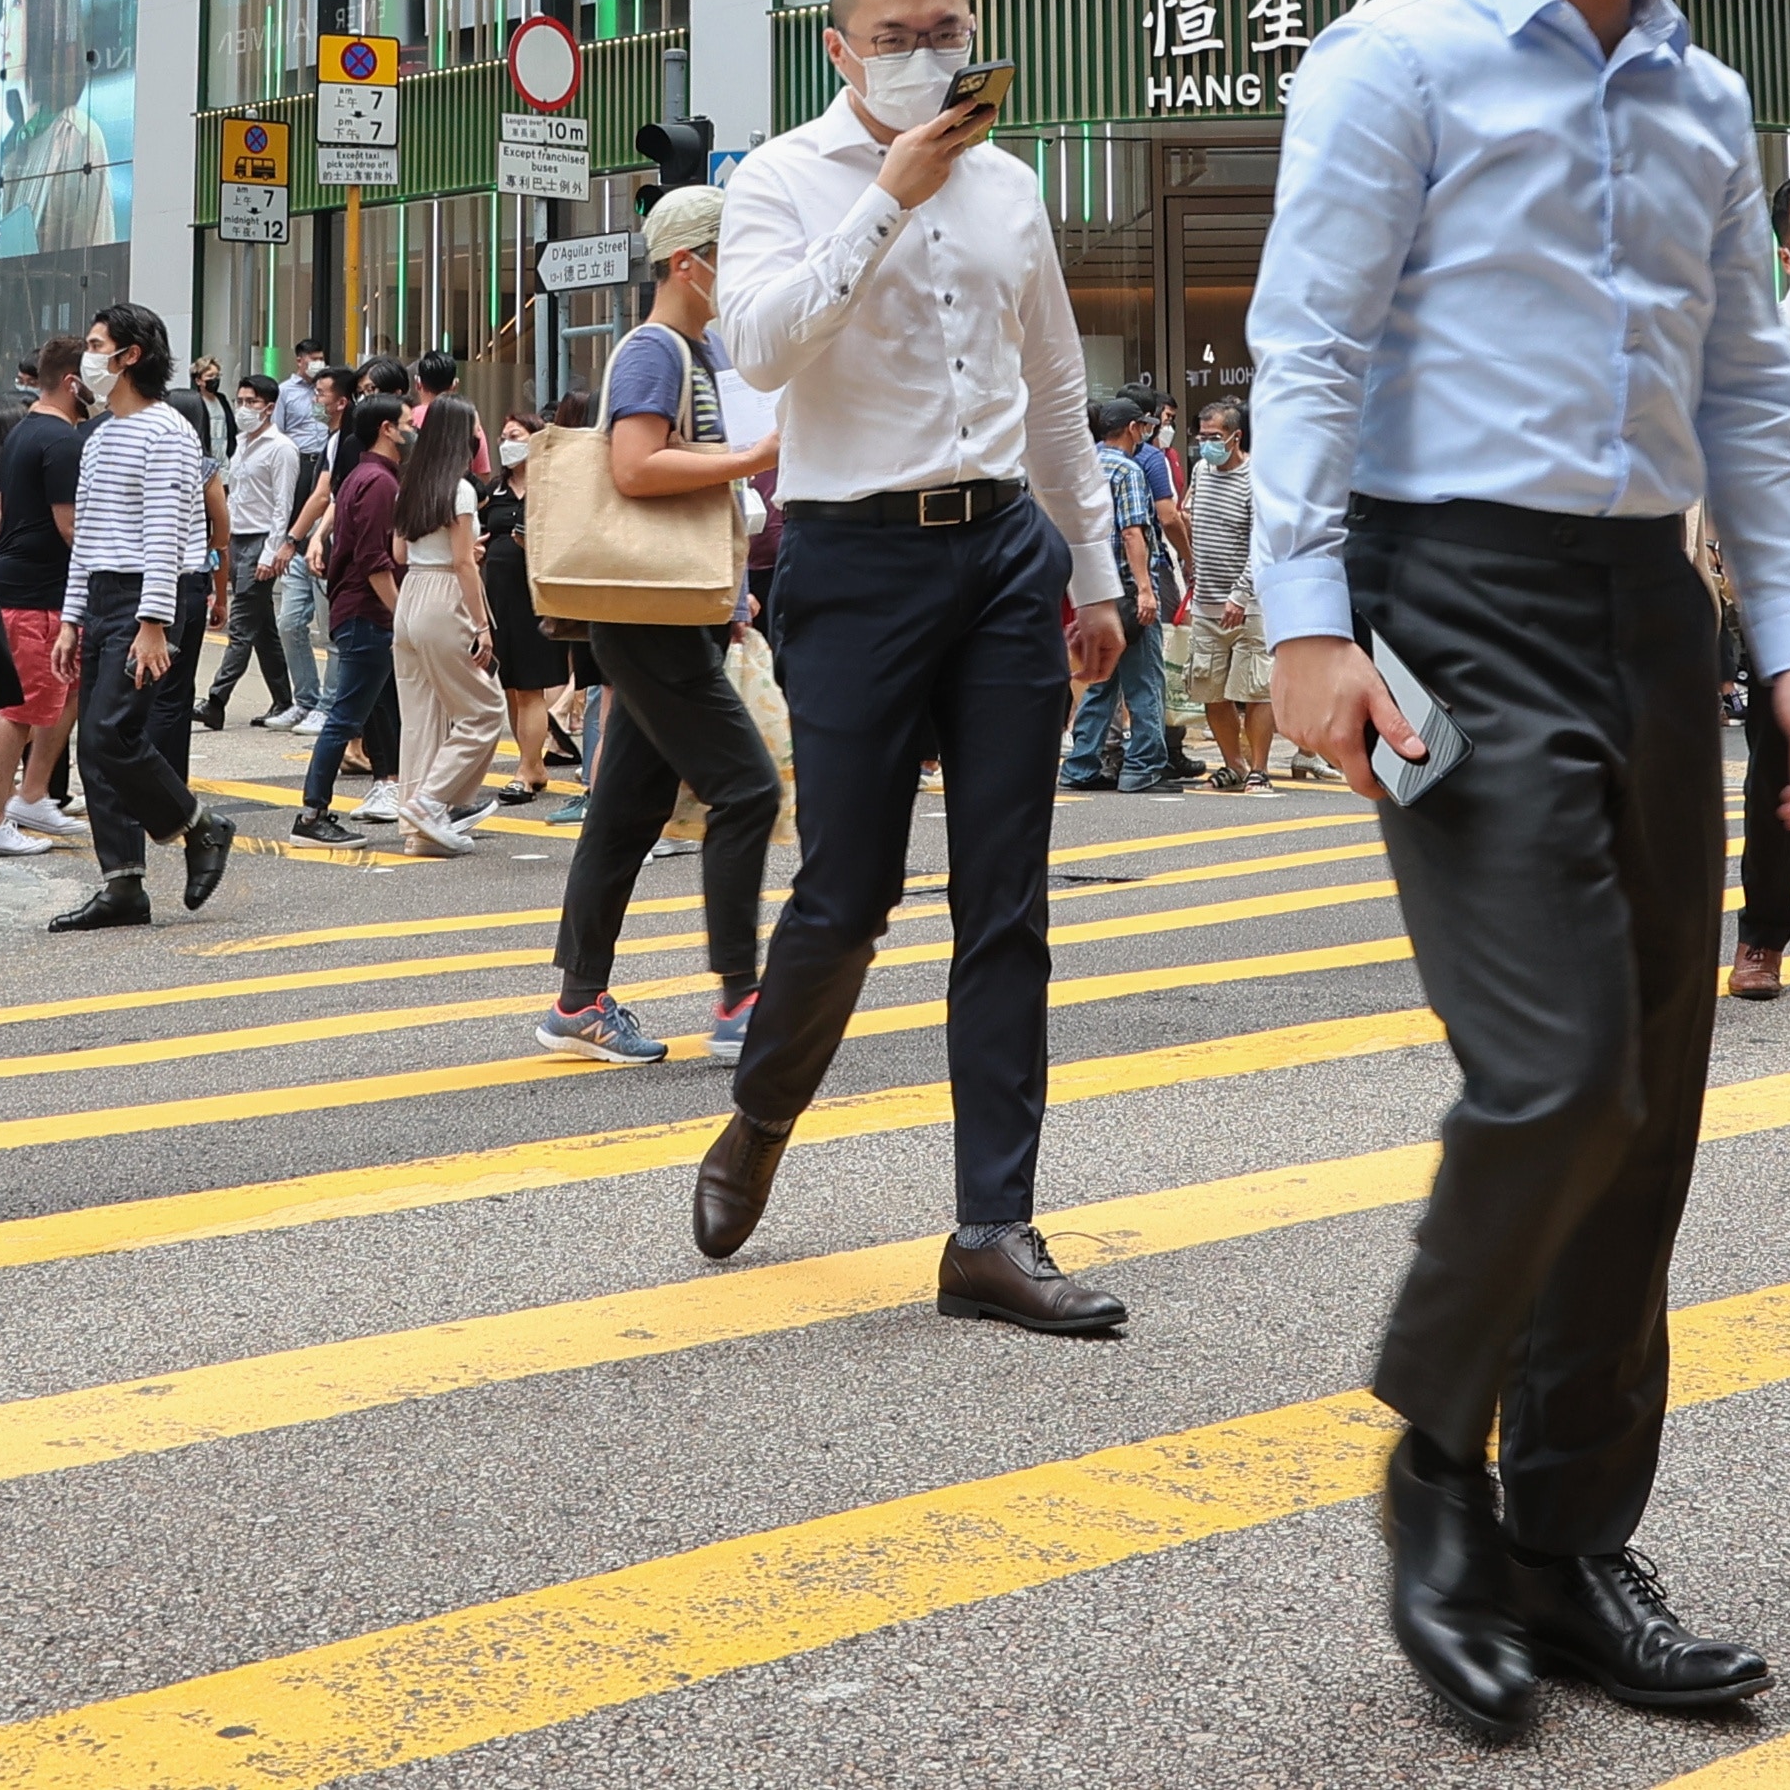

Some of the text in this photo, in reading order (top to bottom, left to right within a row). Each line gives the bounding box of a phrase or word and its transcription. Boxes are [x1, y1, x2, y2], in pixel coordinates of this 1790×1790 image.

[1146, 73, 1261, 108] HANG
[334, 97, 357, 109] 上午
[339, 87, 383, 110] am 7
[505, 116, 527, 126] Length
[334, 128, 356, 140] 下午
[338, 118, 382, 140] pm 7
[336, 151, 379, 160] Except taxi
[503, 147, 585, 165] Except franchised
[327, 161, 389, 171] pick up/drop off
[531, 162, 558, 173] buses
[322, 171, 392, 181] 的士上落客除外
[506, 174, 582, 195] 專利巴士例外
[233, 196, 252, 206] 上午
[263, 190, 274, 208] 7
[224, 215, 283, 238] midnight 12
[232, 226, 251, 237] 午夜
[552, 240, 627, 261] D'Aguilar Street
[564, 260, 615, 283] 德己立街
